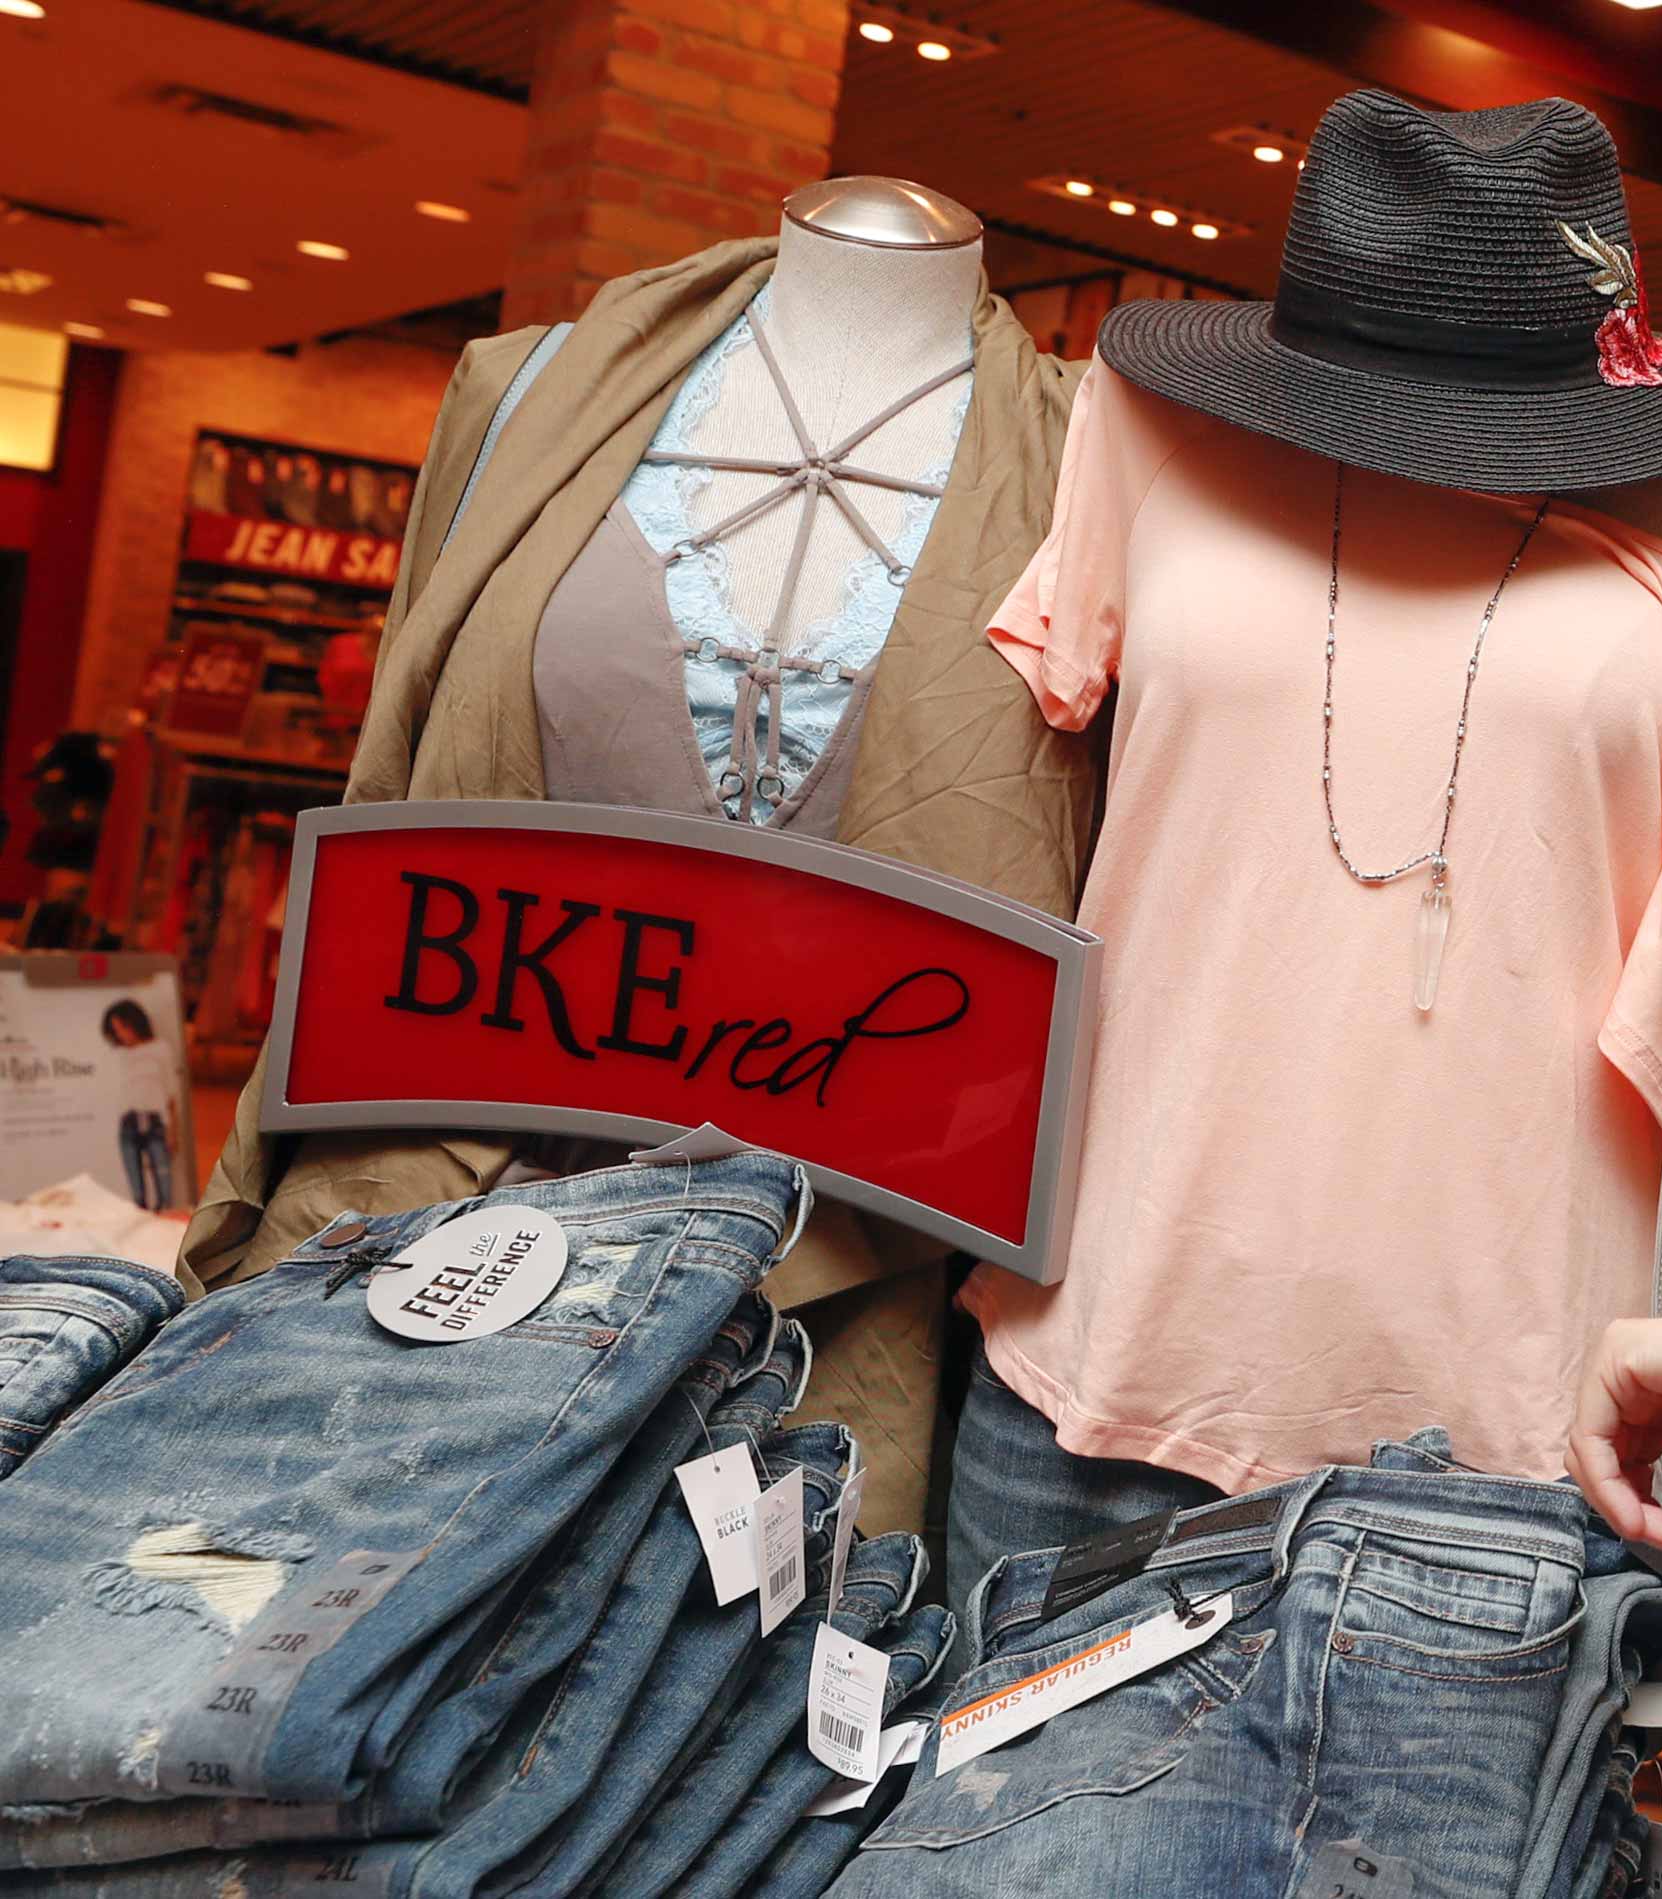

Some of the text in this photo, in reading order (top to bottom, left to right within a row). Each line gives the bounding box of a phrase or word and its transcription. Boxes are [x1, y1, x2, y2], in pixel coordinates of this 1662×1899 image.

[225, 520, 338, 573] JEAN
[384, 871, 970, 1107] BKE red
[399, 1231, 493, 1320] FEEL the
[439, 1229, 542, 1332] DIFFERENCE
[717, 1516, 751, 1540] BLACK
[311, 1587, 361, 1608] 23R
[257, 1632, 309, 1654] 23R
[825, 1660, 852, 1680] SKINNY
[206, 1685, 258, 1715] 23R
[941, 1637, 1133, 1742] REGULAR SKINNY
[186, 1760, 234, 1788] 23R
